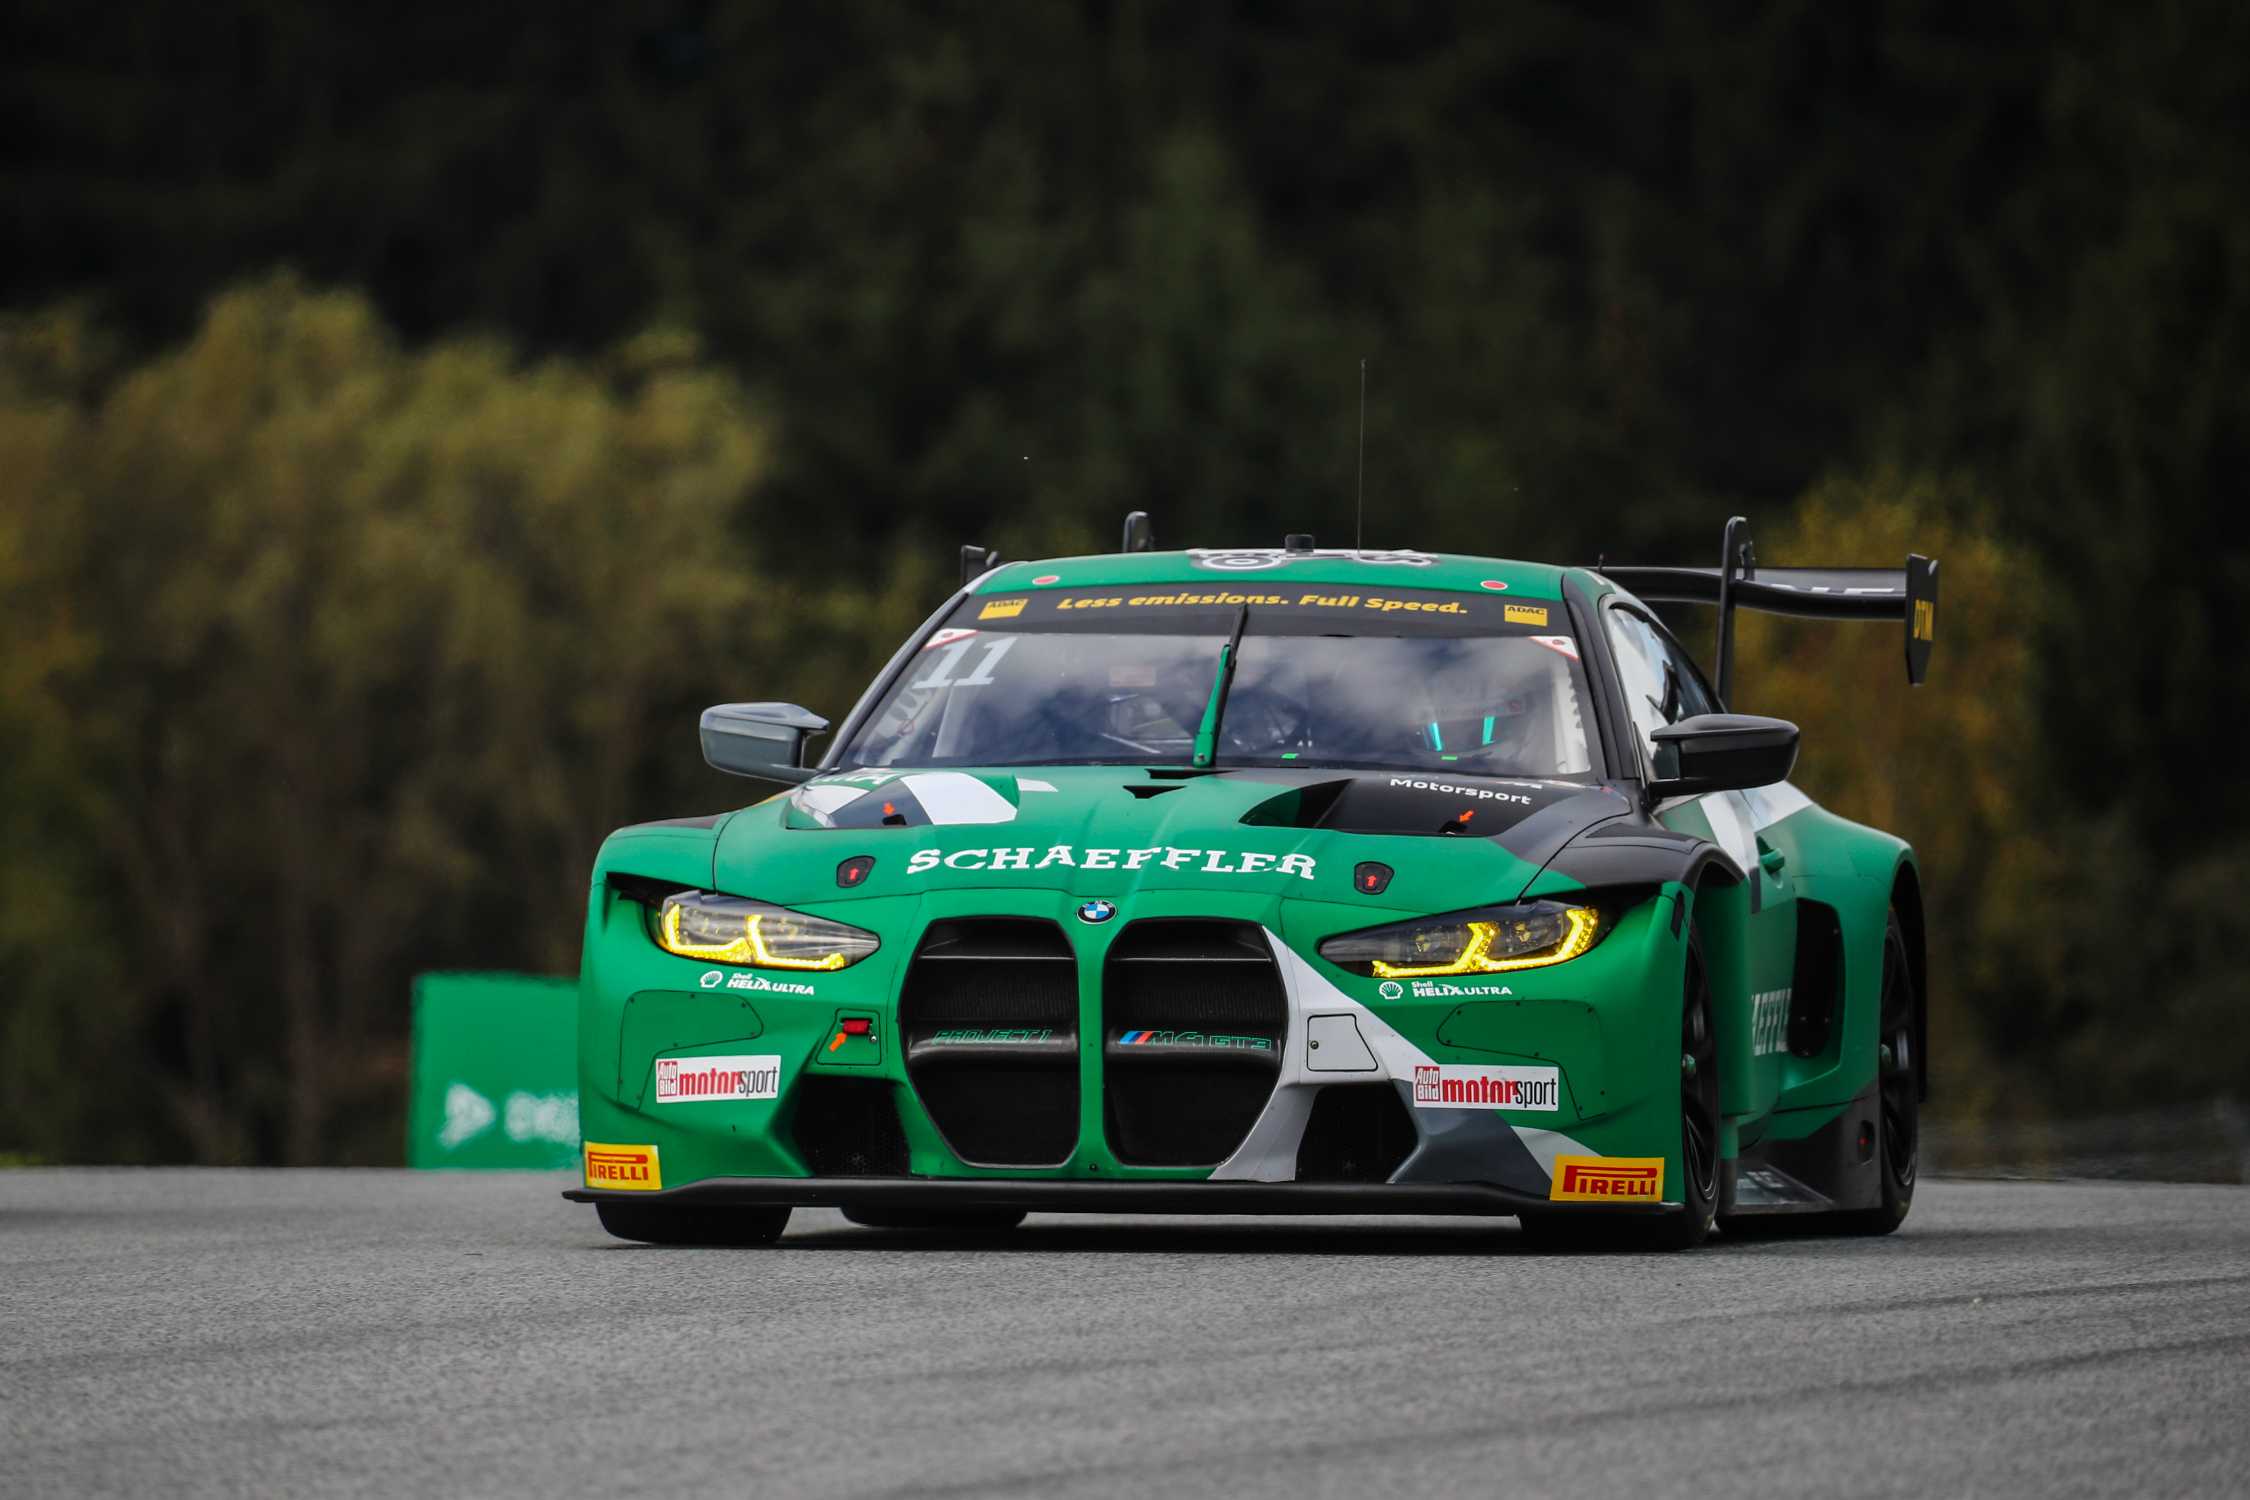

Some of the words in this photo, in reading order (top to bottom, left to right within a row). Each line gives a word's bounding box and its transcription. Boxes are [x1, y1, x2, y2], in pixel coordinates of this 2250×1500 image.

[1056, 597, 1123, 609] Less
[1128, 592, 1289, 606] emissions.
[1299, 594, 1360, 607] Full
[1364, 597, 1468, 614] Speed.
[912, 636, 1018, 689] 11
[1390, 778, 1532, 805] Motorsport
[906, 845, 1316, 880] SCHAEFFLER
[771, 982, 815, 995] ULTRA
[1412, 983, 1464, 997] HELIX
[1464, 986, 1513, 995] ULTRA
[1209, 1035, 1272, 1050] GT3
[1416, 1067, 1440, 1085] Auto
[1417, 1085, 1440, 1100] Bild
[588, 1152, 649, 1180] PIRELLI
[1563, 1165, 1657, 1195] PIRELLI
